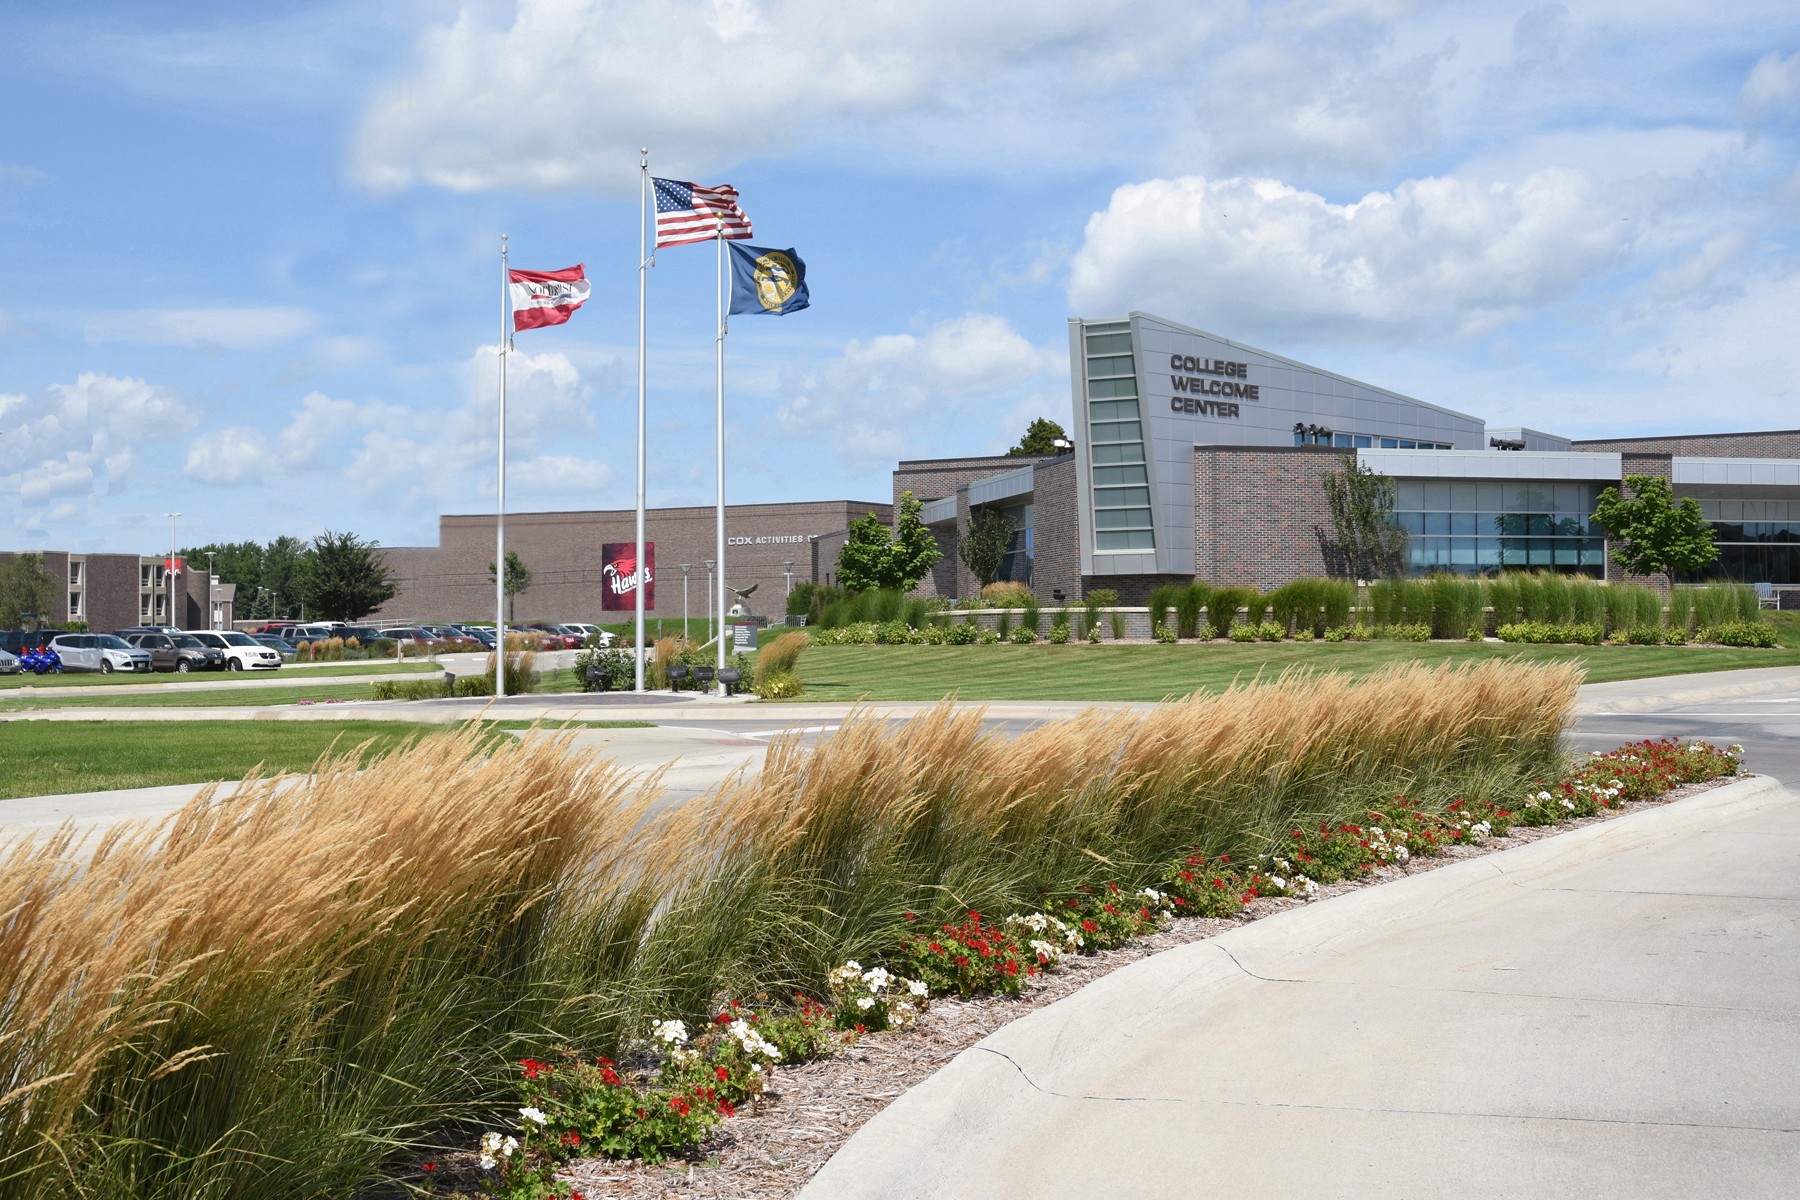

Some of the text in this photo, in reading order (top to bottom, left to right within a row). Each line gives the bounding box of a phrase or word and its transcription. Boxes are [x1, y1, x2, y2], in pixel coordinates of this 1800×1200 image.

[1171, 354, 1247, 378] COLLEGE
[1171, 375, 1259, 399] WELCOME
[1171, 397, 1239, 417] CENTER
[728, 536, 752, 546] COX
[755, 535, 803, 545] ACTIVITIES
[611, 567, 653, 594] Haws
